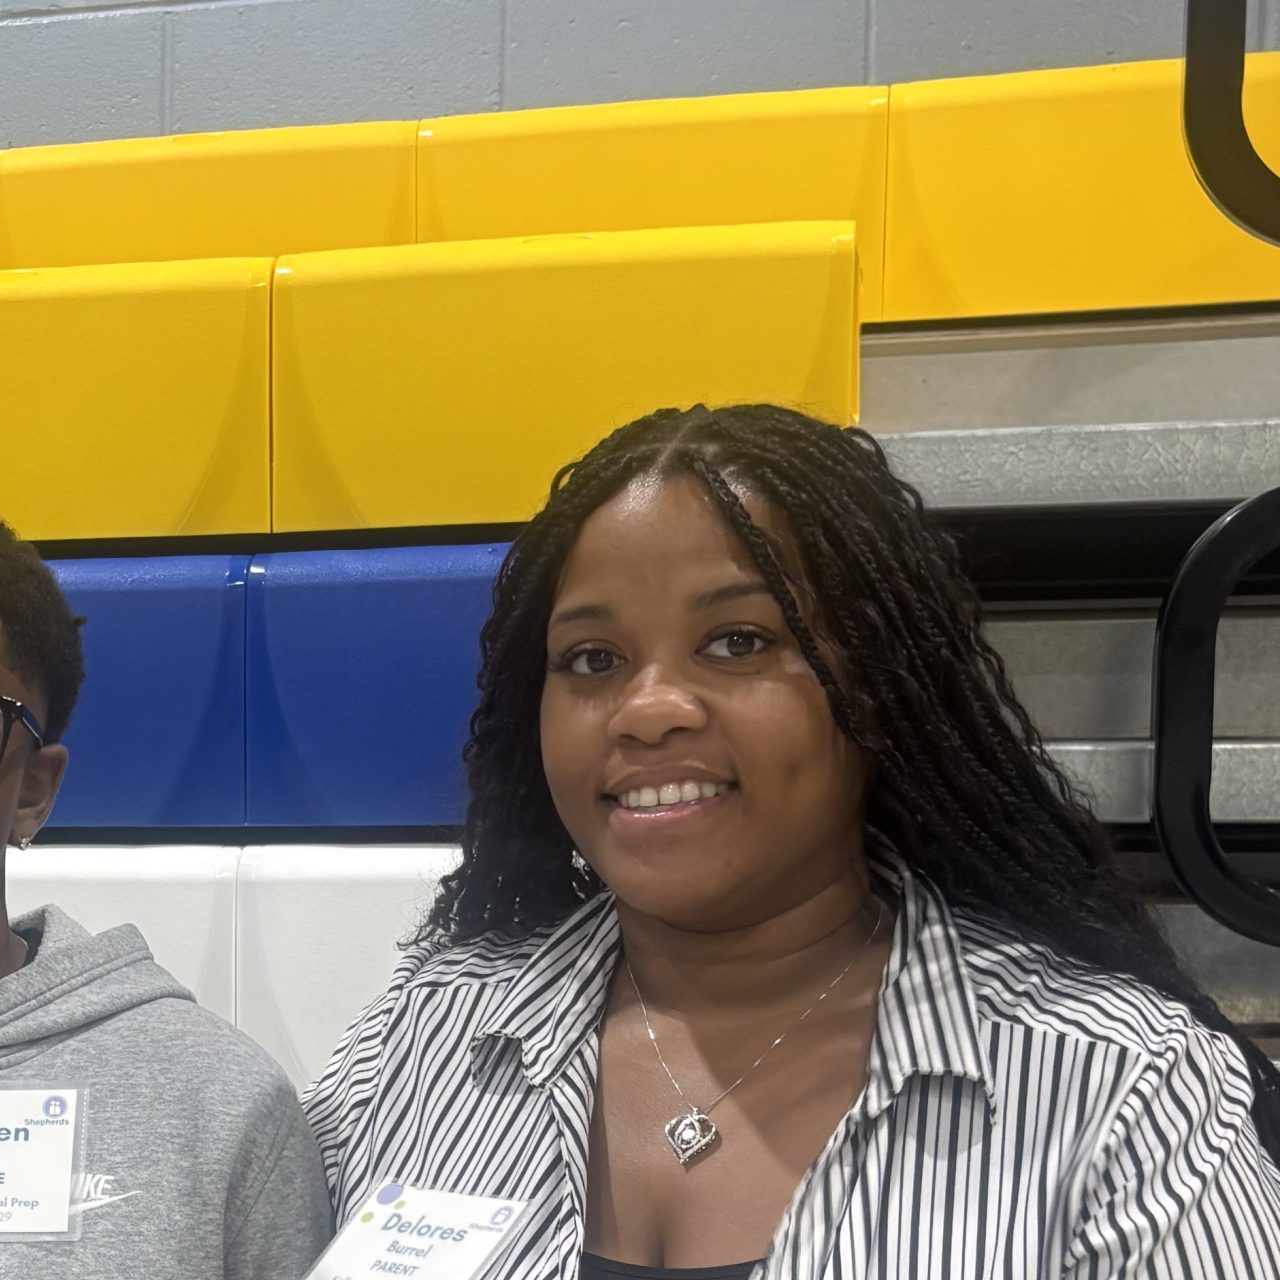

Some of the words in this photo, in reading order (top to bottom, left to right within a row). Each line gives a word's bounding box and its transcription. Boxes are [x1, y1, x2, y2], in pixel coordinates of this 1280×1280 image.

[25, 1118, 69, 1126] Shepherds
[11, 1198, 39, 1210] Prep
[381, 1212, 468, 1243] Delores
[386, 1240, 433, 1259] Burrel
[370, 1259, 420, 1277] PARENT
